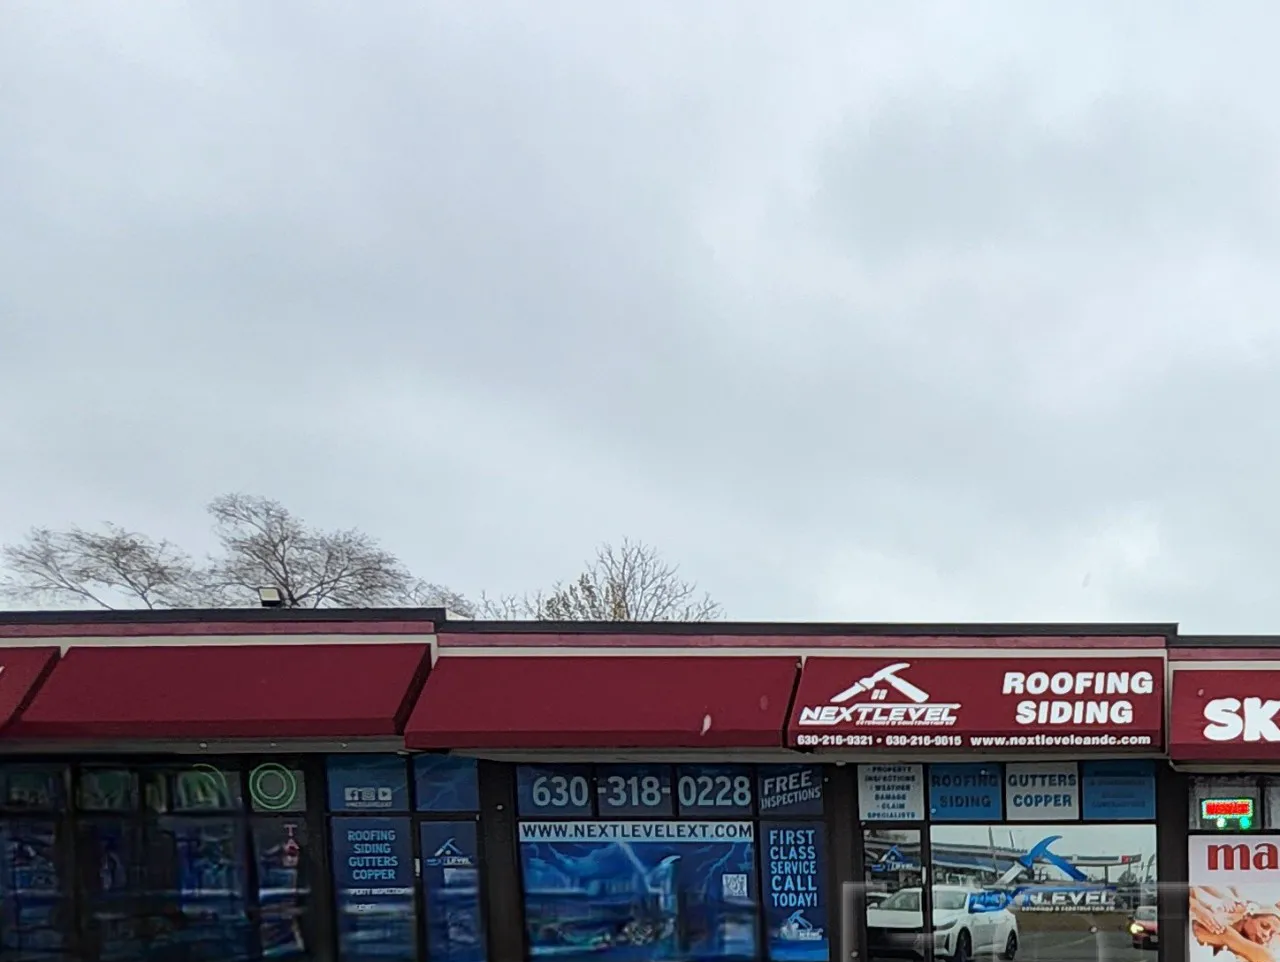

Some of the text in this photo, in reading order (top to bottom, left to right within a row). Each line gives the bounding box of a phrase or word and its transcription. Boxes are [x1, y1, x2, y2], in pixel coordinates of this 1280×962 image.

[1002, 672, 1153, 694] ROOFING
[1016, 701, 1133, 724] SIDING
[763, 769, 813, 796] FREE
[931, 774, 999, 787] ROOFING
[1008, 774, 1076, 787] GUTTERS
[761, 785, 822, 809] INSPECTIONS
[940, 796, 991, 807] SIDING
[1013, 794, 1072, 807] COPPER
[347, 830, 396, 841] ROOFING
[522, 824, 752, 838] WWW.NEXTLEVELEXT.COM
[769, 829, 816, 845] FIRST
[353, 843, 391, 854] SIDING
[769, 846, 816, 860] CLASS
[348, 856, 399, 867] GUTTERS
[770, 861, 817, 875] SERVICE
[352, 869, 396, 880] COPPER
[771, 875, 818, 891] CALL
[771, 892, 818, 907] TODAY!
